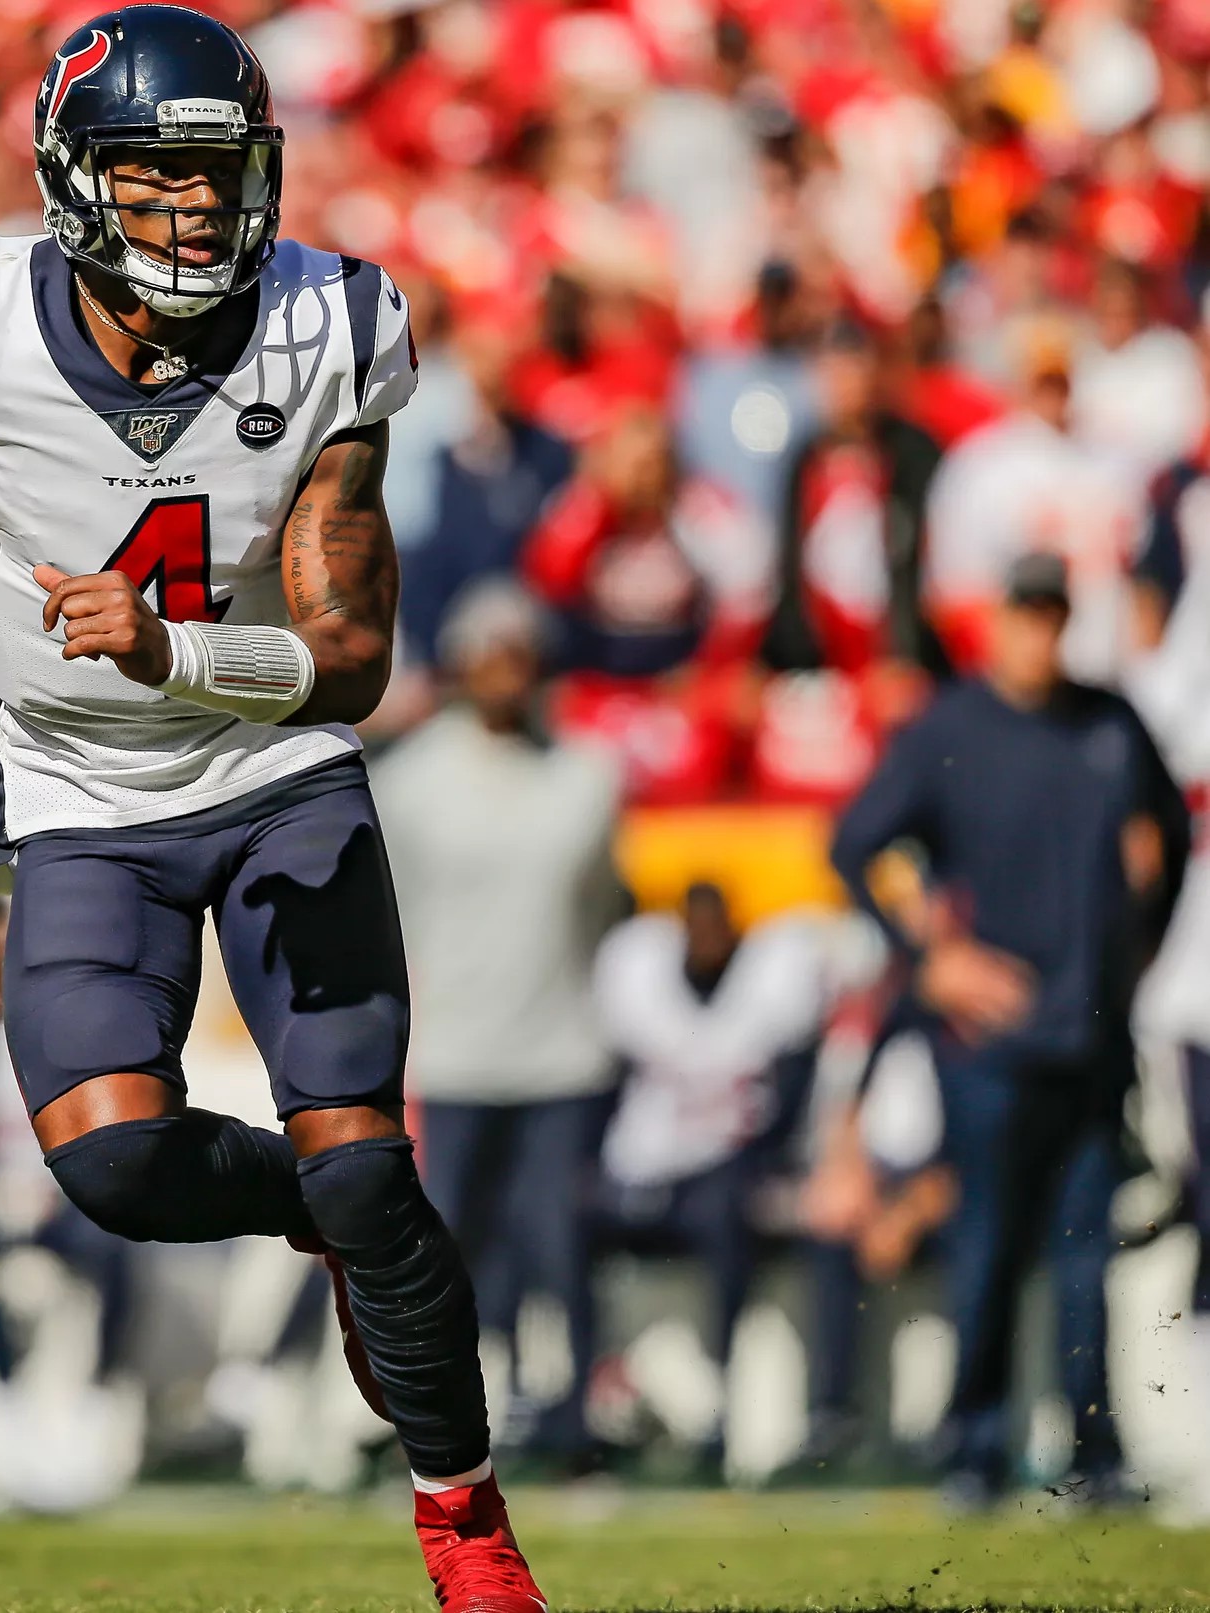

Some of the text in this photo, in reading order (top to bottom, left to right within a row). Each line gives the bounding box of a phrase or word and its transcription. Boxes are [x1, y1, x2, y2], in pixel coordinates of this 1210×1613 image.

[248, 420, 273, 432] RCM
[101, 473, 196, 488] TEXANS
[97, 493, 234, 624] 4
[291, 556, 302, 580] me
